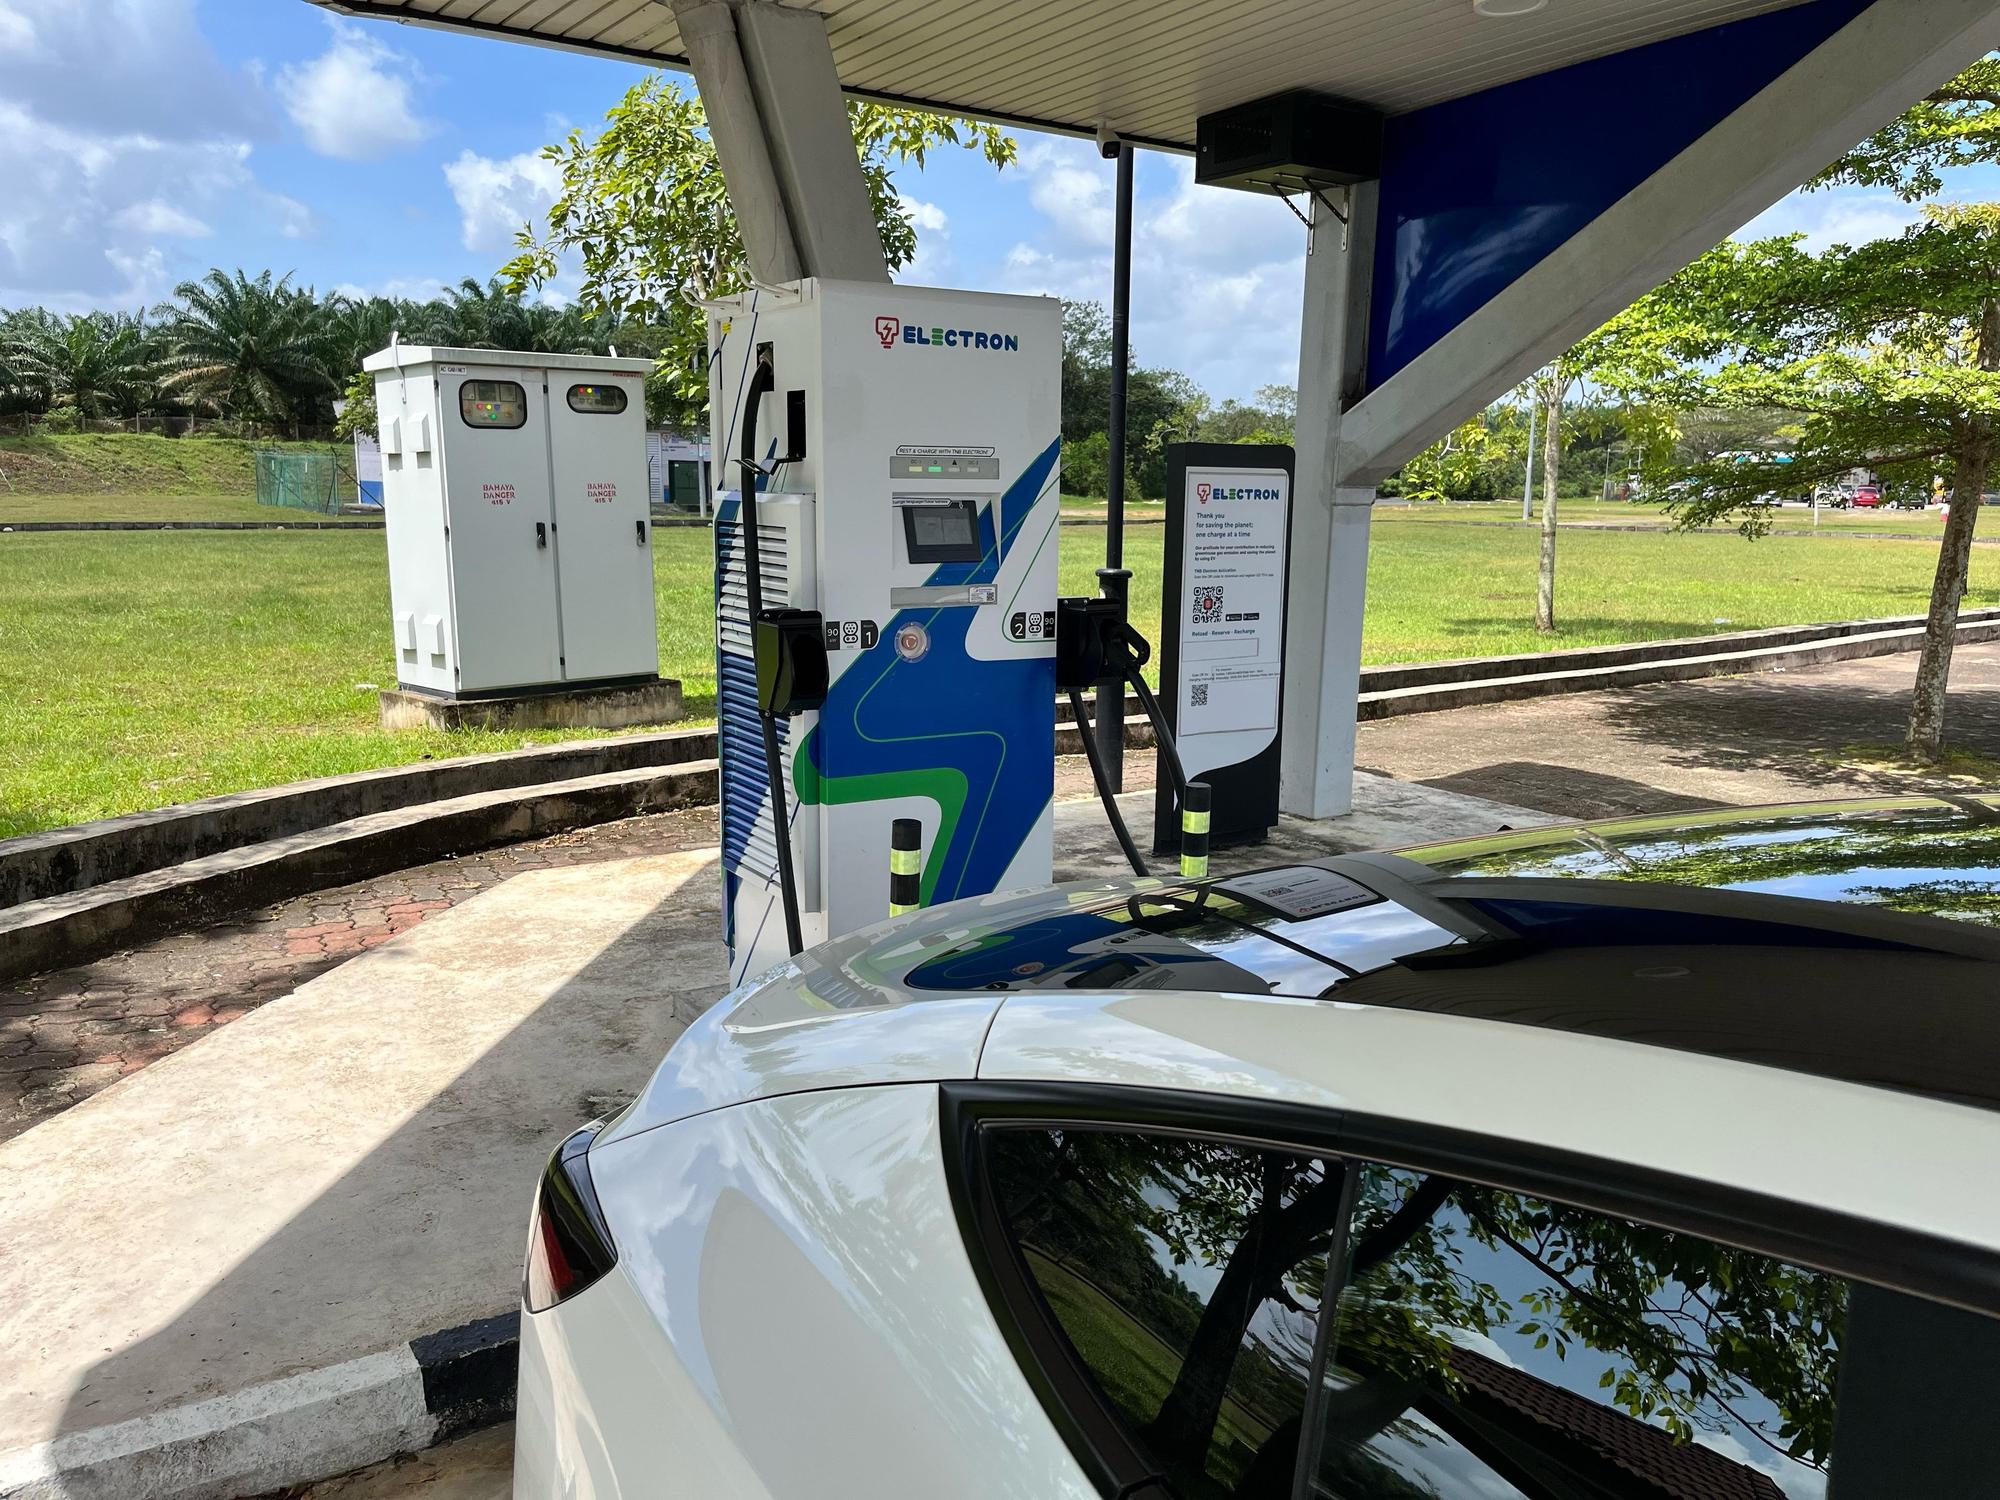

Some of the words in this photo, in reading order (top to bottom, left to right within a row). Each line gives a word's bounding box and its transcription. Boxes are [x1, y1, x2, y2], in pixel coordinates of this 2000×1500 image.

[903, 325, 1018, 352] ELECTRON
[483, 491, 516, 499] DANGER
[1213, 488, 1280, 500] ELECTRON
[1045, 617, 1055, 626] 90
[827, 628, 839, 637] 90
[1015, 623, 1024, 636] 2
[866, 631, 871, 645] 1
